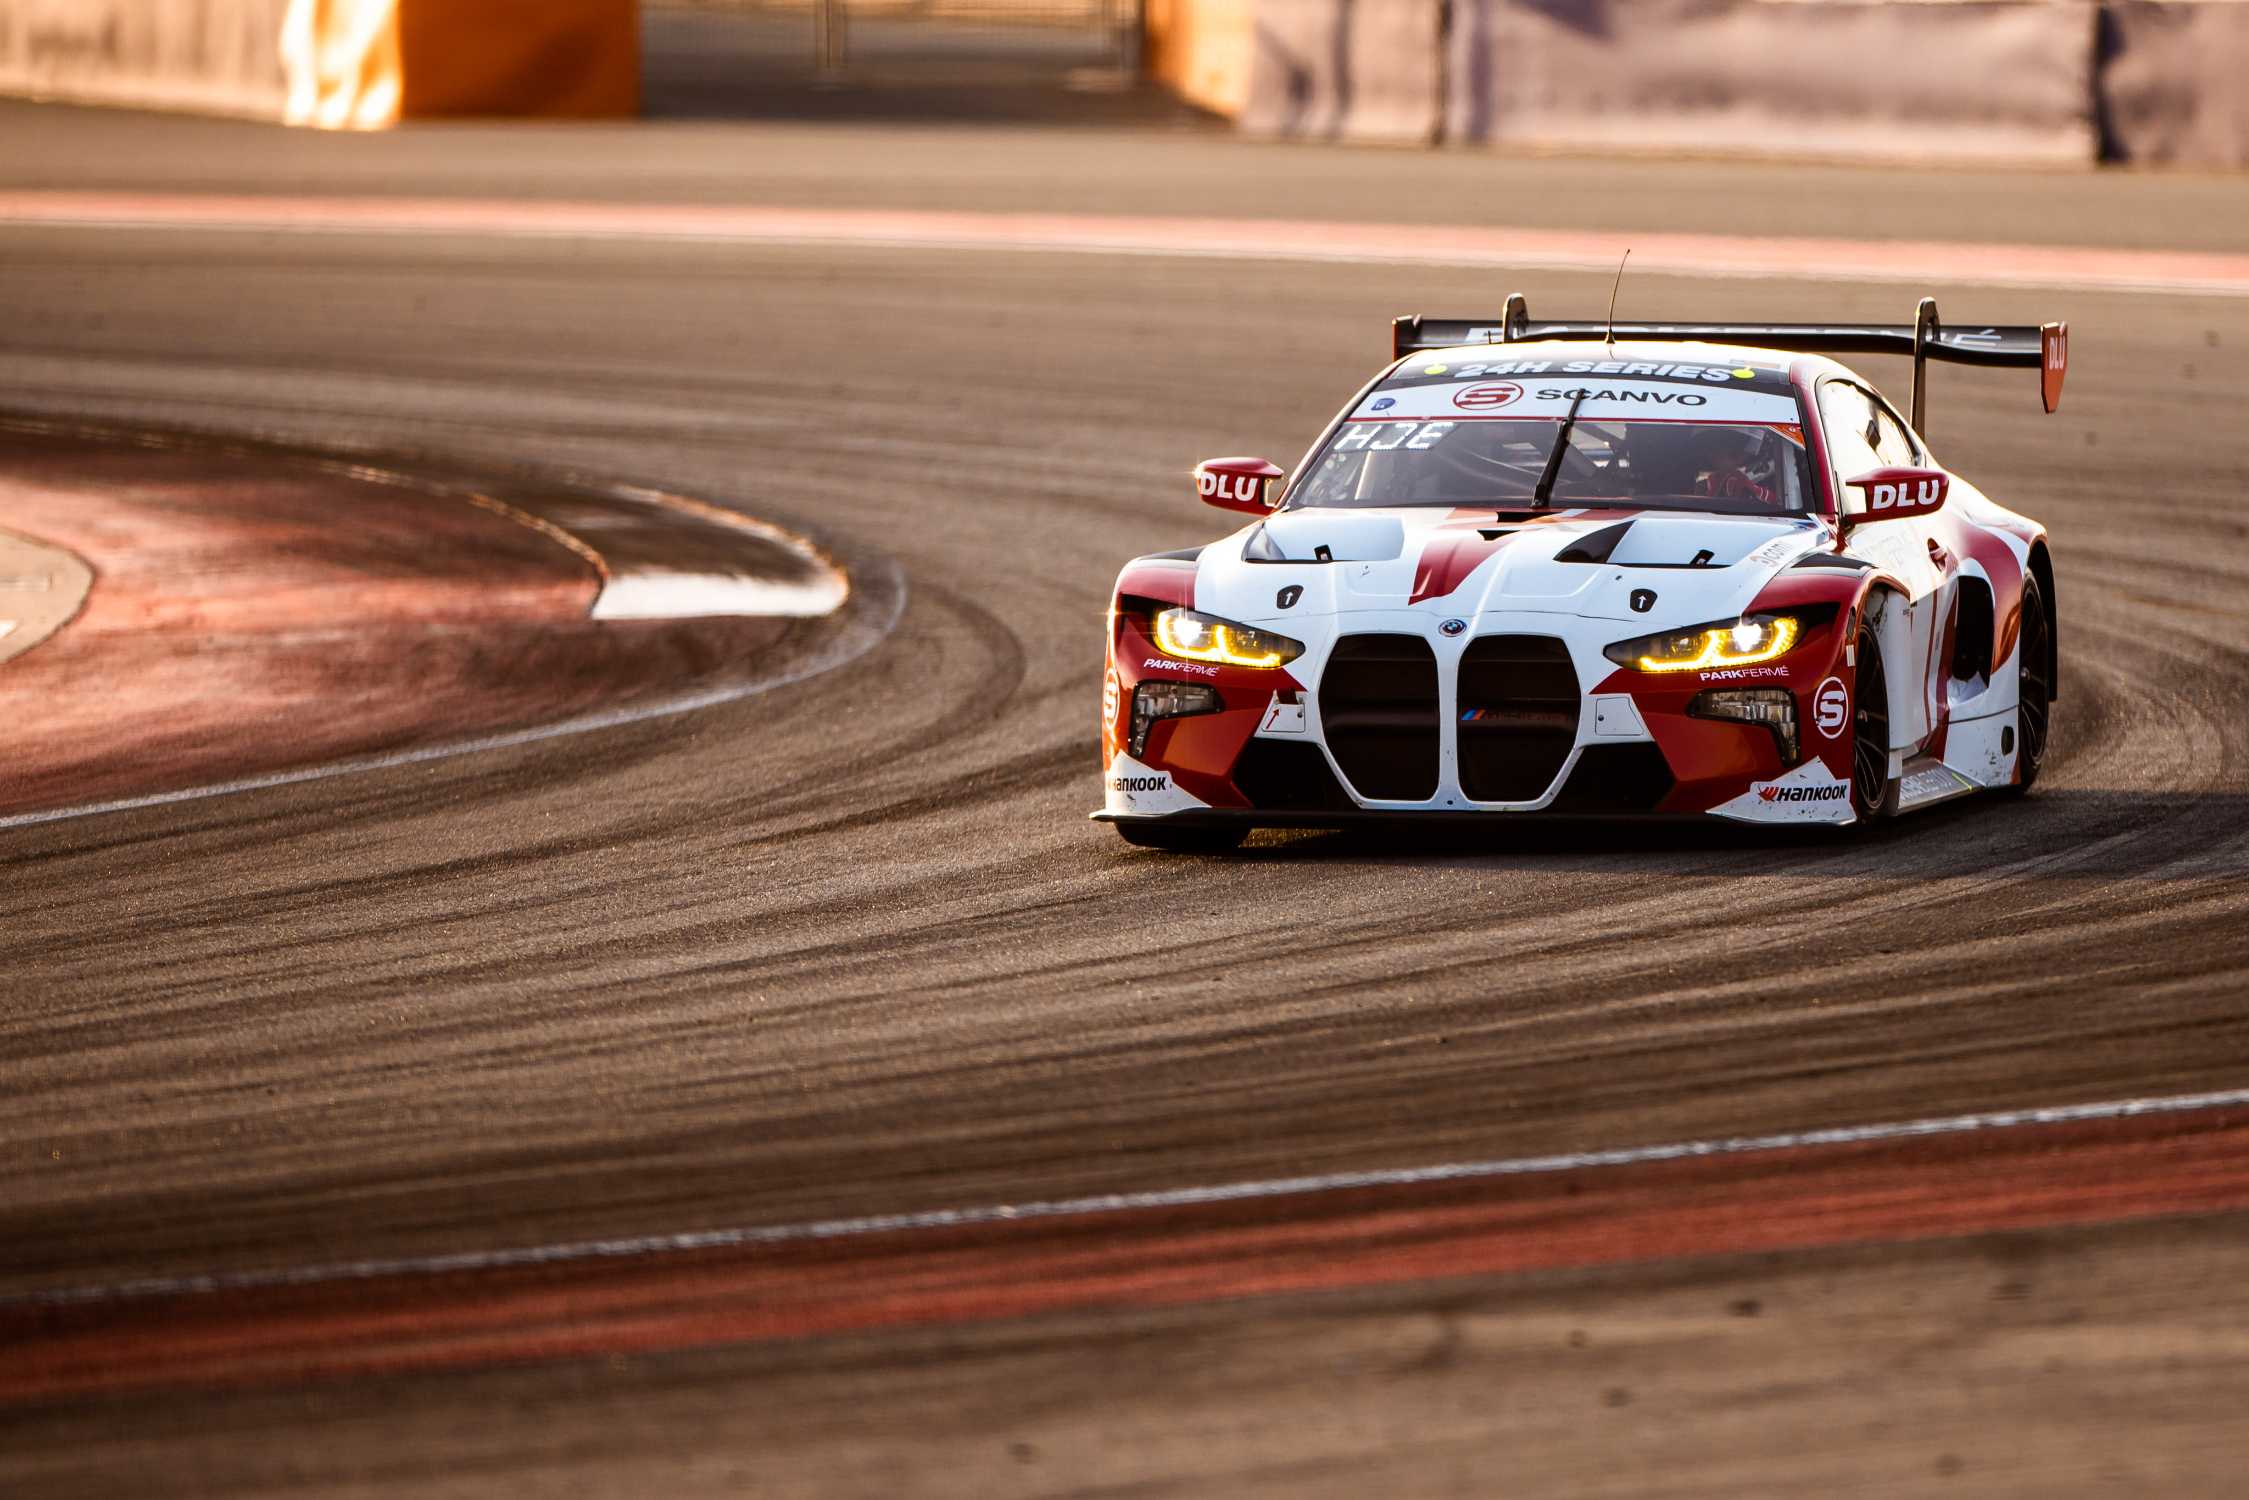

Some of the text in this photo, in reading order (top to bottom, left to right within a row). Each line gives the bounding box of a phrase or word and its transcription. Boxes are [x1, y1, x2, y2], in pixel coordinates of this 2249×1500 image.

[1455, 361, 1732, 382] 24H SERIES
[1535, 388, 1708, 406] SCANVO
[1333, 421, 1454, 450] HJE
[1200, 471, 1258, 501] DLU
[1872, 479, 1939, 509] DLU
